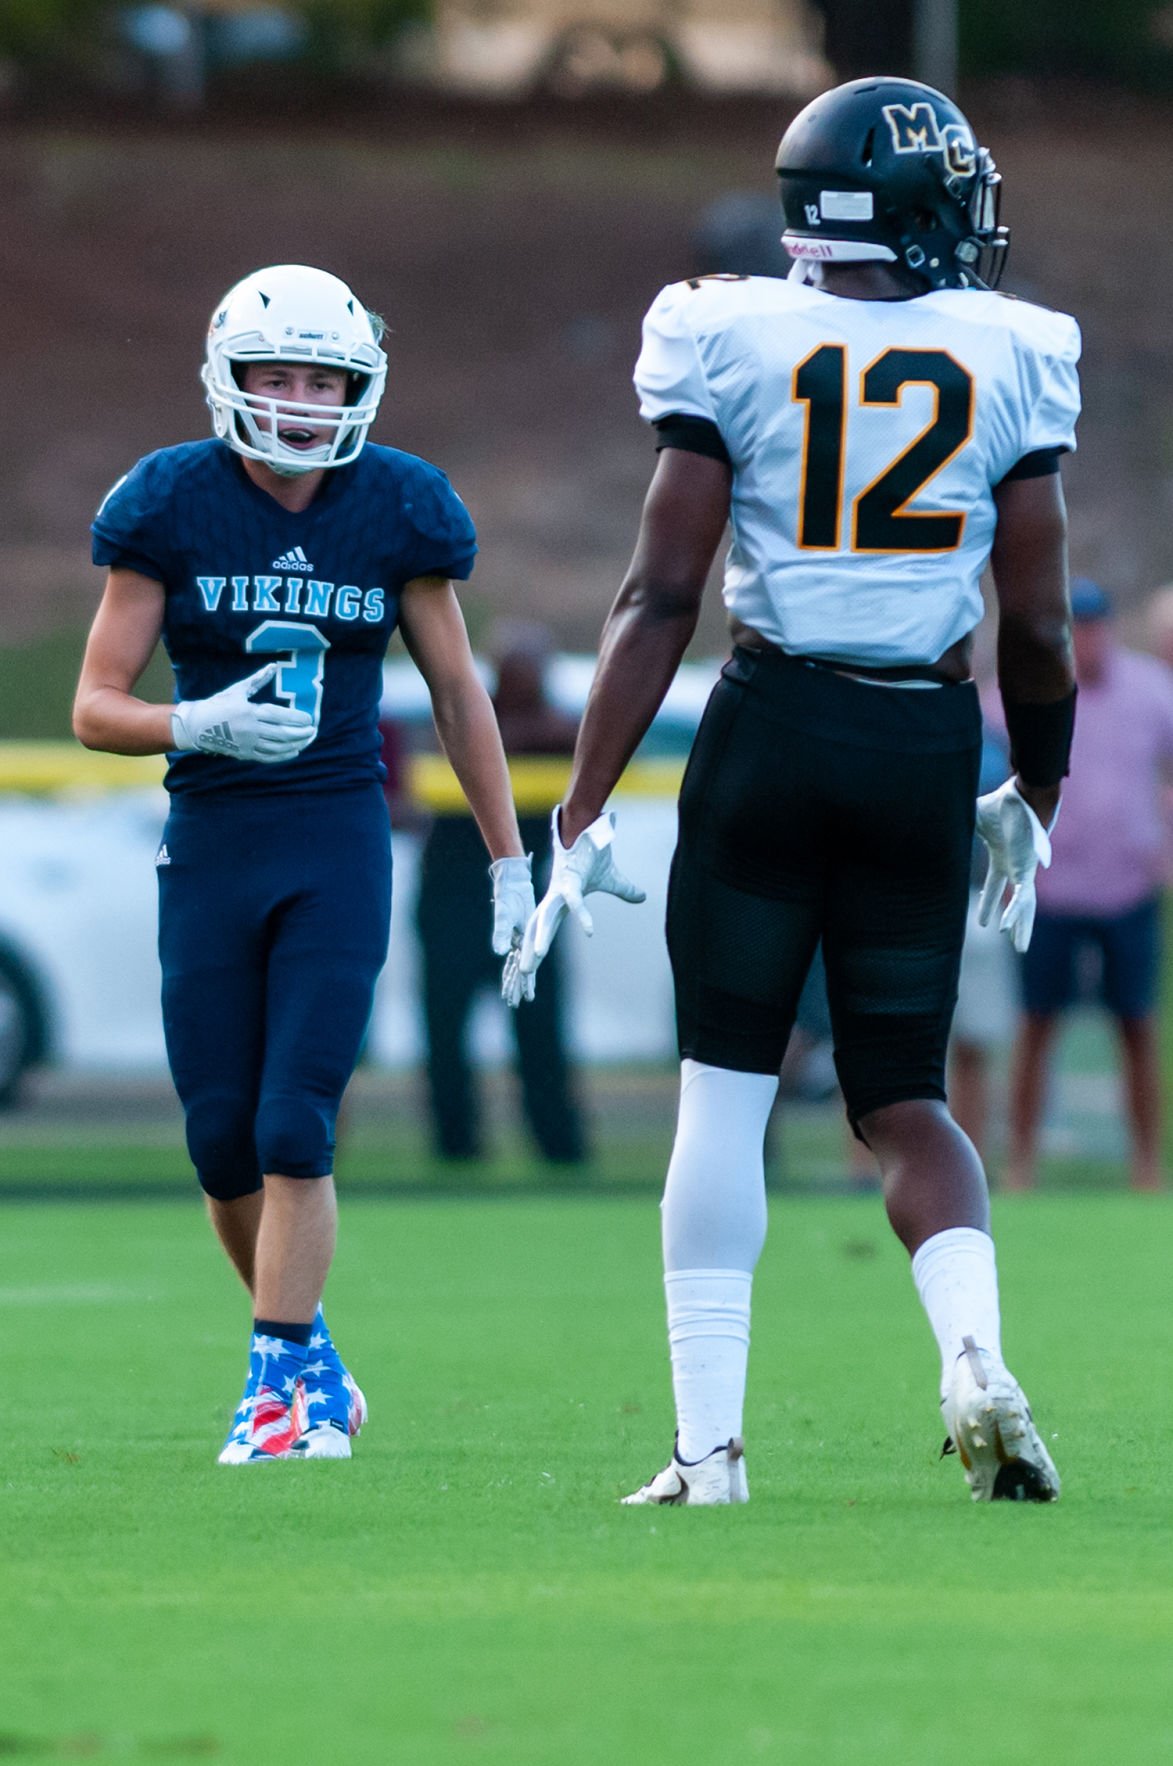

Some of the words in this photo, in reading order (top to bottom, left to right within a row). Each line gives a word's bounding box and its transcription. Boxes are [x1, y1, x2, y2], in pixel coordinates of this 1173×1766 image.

[804, 204, 821, 225] 12
[791, 342, 975, 554] 12
[272, 560, 314, 572] adidas
[197, 575, 385, 622] VIKINGS
[246, 619, 332, 746] 3
[199, 734, 240, 752] adidas
